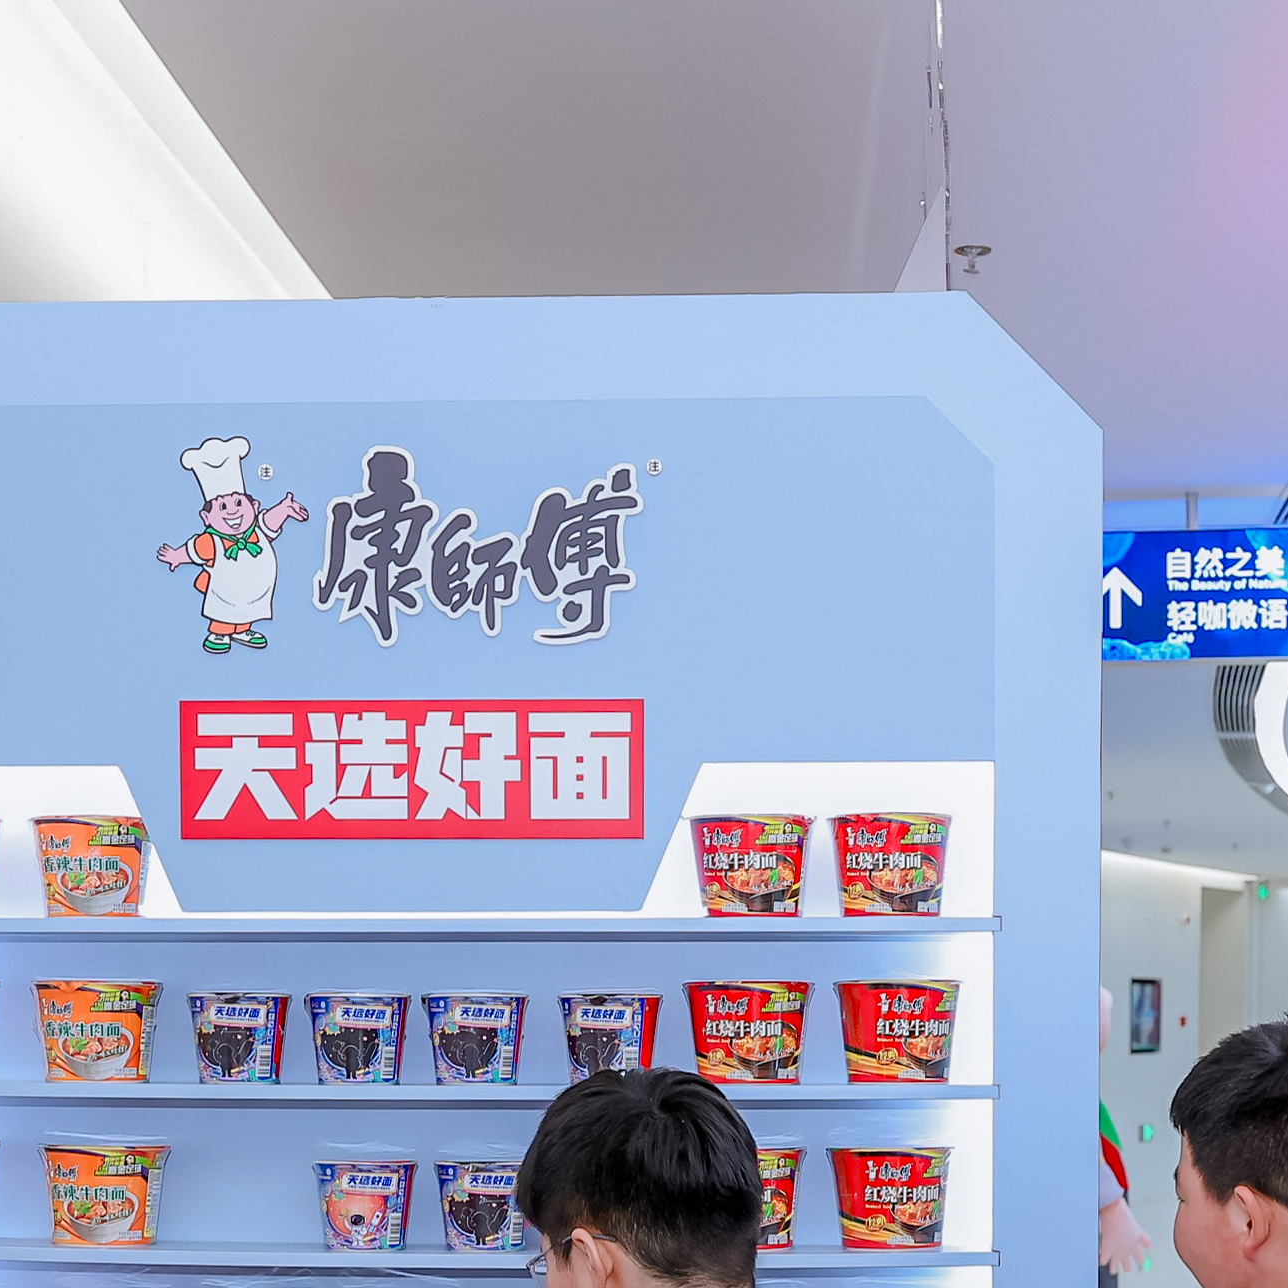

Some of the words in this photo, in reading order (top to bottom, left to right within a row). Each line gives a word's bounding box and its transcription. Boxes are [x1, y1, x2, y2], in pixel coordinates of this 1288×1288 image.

[1166, 546, 1285, 579] 自然之美
[1167, 580, 1189, 591] The
[1191, 579, 1231, 592] Beauty
[1233, 579, 1246, 589] of
[1248, 578, 1288, 589] Nature
[194, 711, 632, 820] 天选好面
[44, 855, 120, 872] 香辣牛肉面
[702, 852, 777, 869] 红烧牛肉面
[846, 852, 921, 869] 红烧牛肉面
[214, 1006, 261, 1018] 天选好面
[339, 1007, 387, 1019] 天选好面
[459, 1006, 505, 1018] 天选好面
[579, 1007, 626, 1018] 天选好面
[45, 1022, 122, 1038] 香辣牛肉面
[705, 1019, 782, 1036] 红烧牛肉面
[877, 1018, 950, 1036] 红烧牛肉面
[347, 1175, 392, 1186] 天选好面
[469, 1175, 515, 1186] 天选好面
[52, 1184, 126, 1201] 香辣牛肉面
[865, 1186, 939, 1202] 红烧牛肉面
